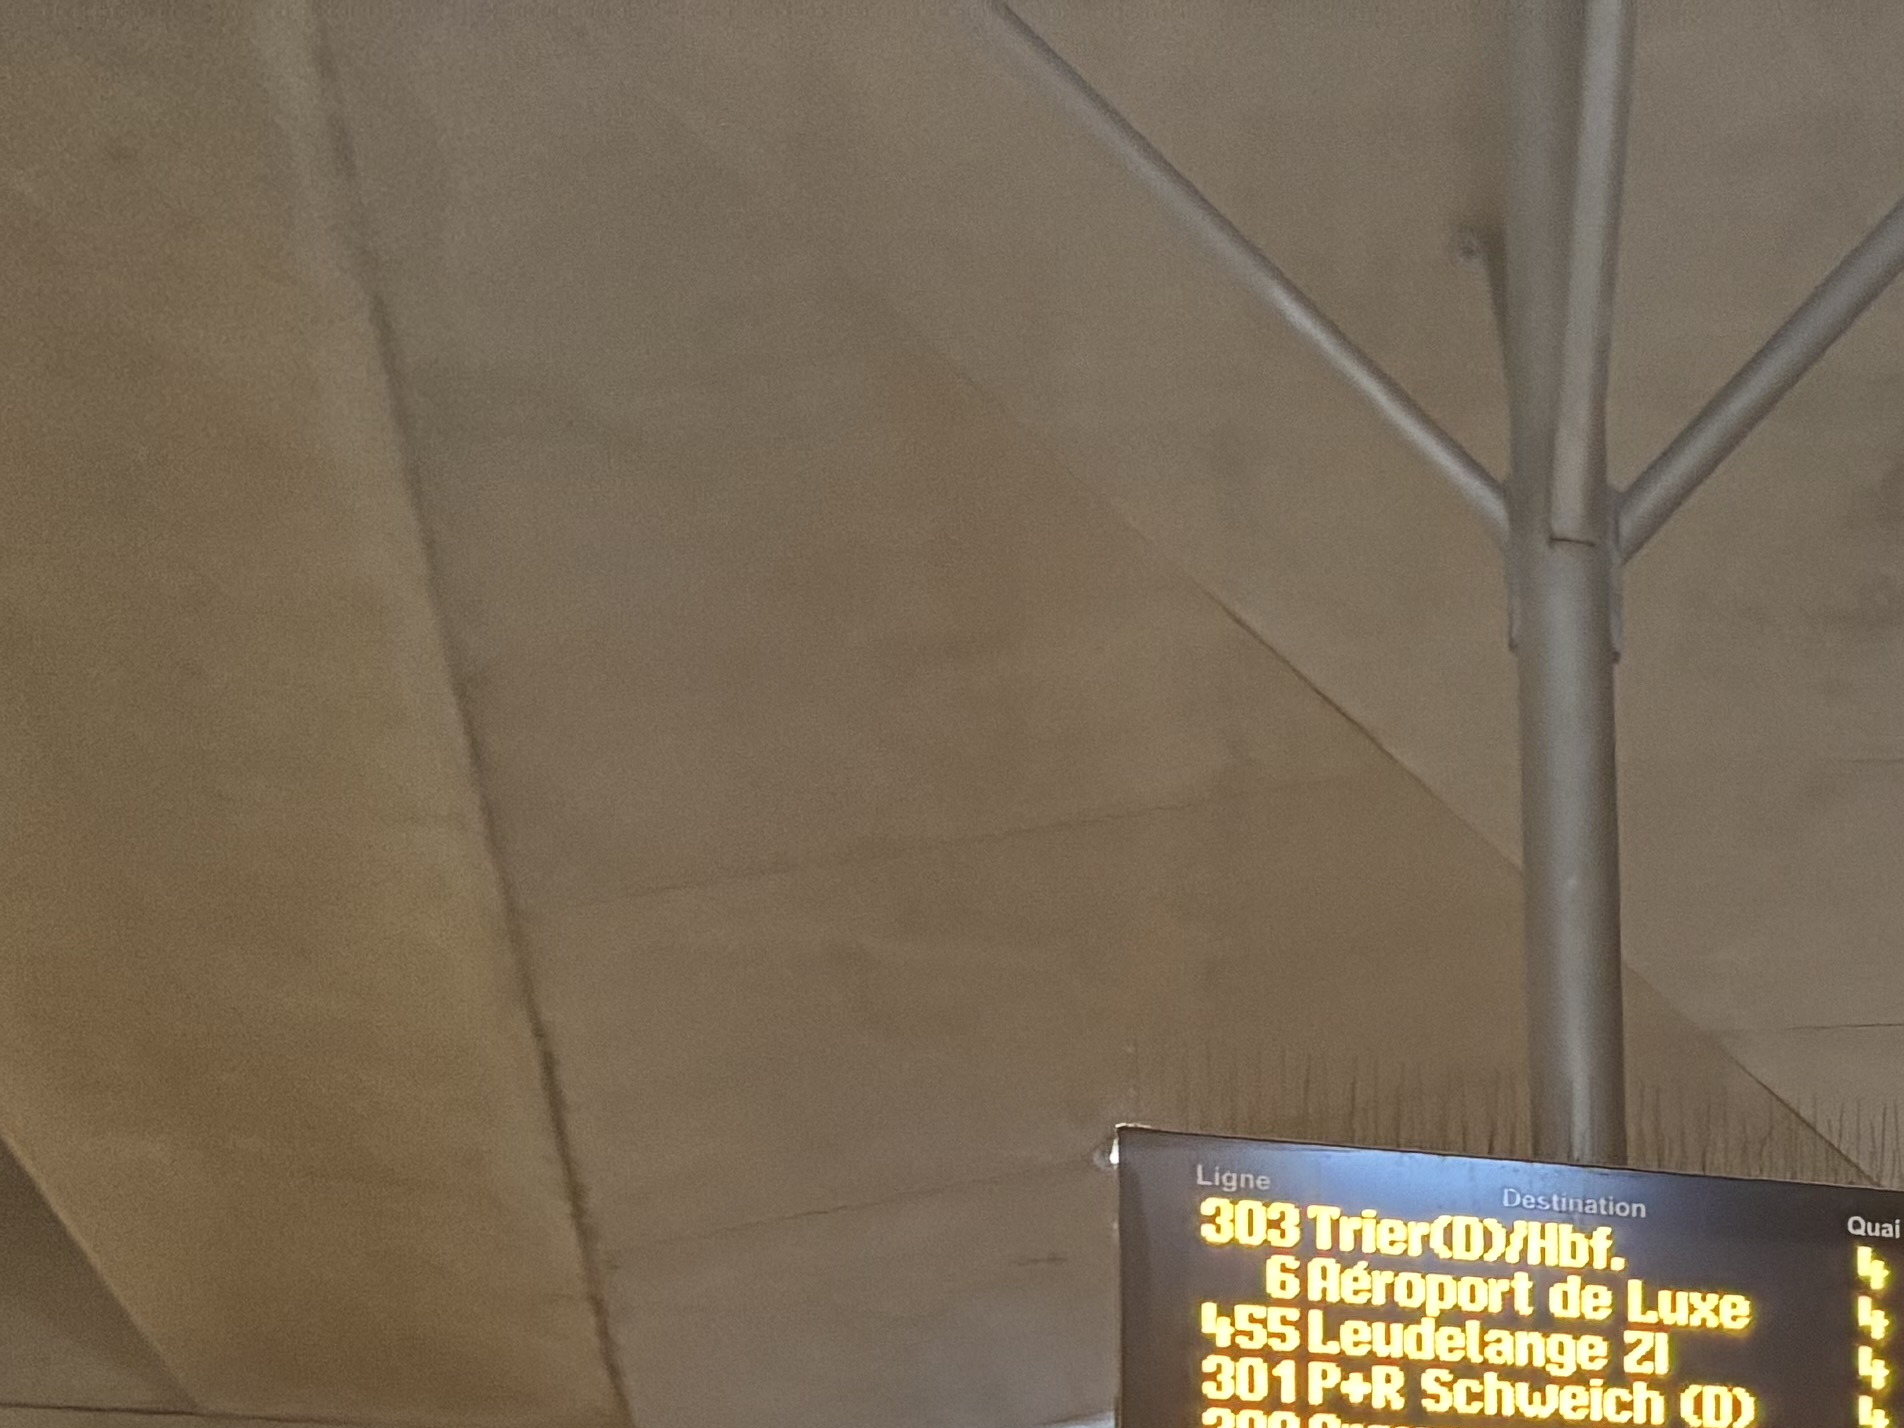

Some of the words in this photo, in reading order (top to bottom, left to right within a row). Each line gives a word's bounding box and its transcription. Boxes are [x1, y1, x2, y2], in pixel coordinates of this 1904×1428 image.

[1195, 1164, 1271, 1192] Ligne
[1502, 1187, 1648, 1219] Destination
[1846, 1215, 1901, 1240] Quai
[1200, 1197, 1301, 1248] 303
[1306, 1204, 1625, 1271] Trier(D)/Hbf.
[1857, 1246, 1890, 1290] 4
[1265, 1254, 1301, 1300] 6
[1307, 1257, 1534, 1316] Aéroport
[1548, 1274, 1613, 1321] de
[1627, 1279, 1751, 1330] Luxe
[1857, 1296, 1890, 1340] 4
[1201, 1301, 1301, 1352] 455
[1307, 1308, 1609, 1377] Leudelange
[1623, 1330, 1669, 1375] ZI
[1858, 1346, 1890, 1390] 4
[1201, 1354, 1296, 1404] 301
[1307, 1361, 1405, 1411] P+R
[1420, 1368, 1665, 1425] Schweich
